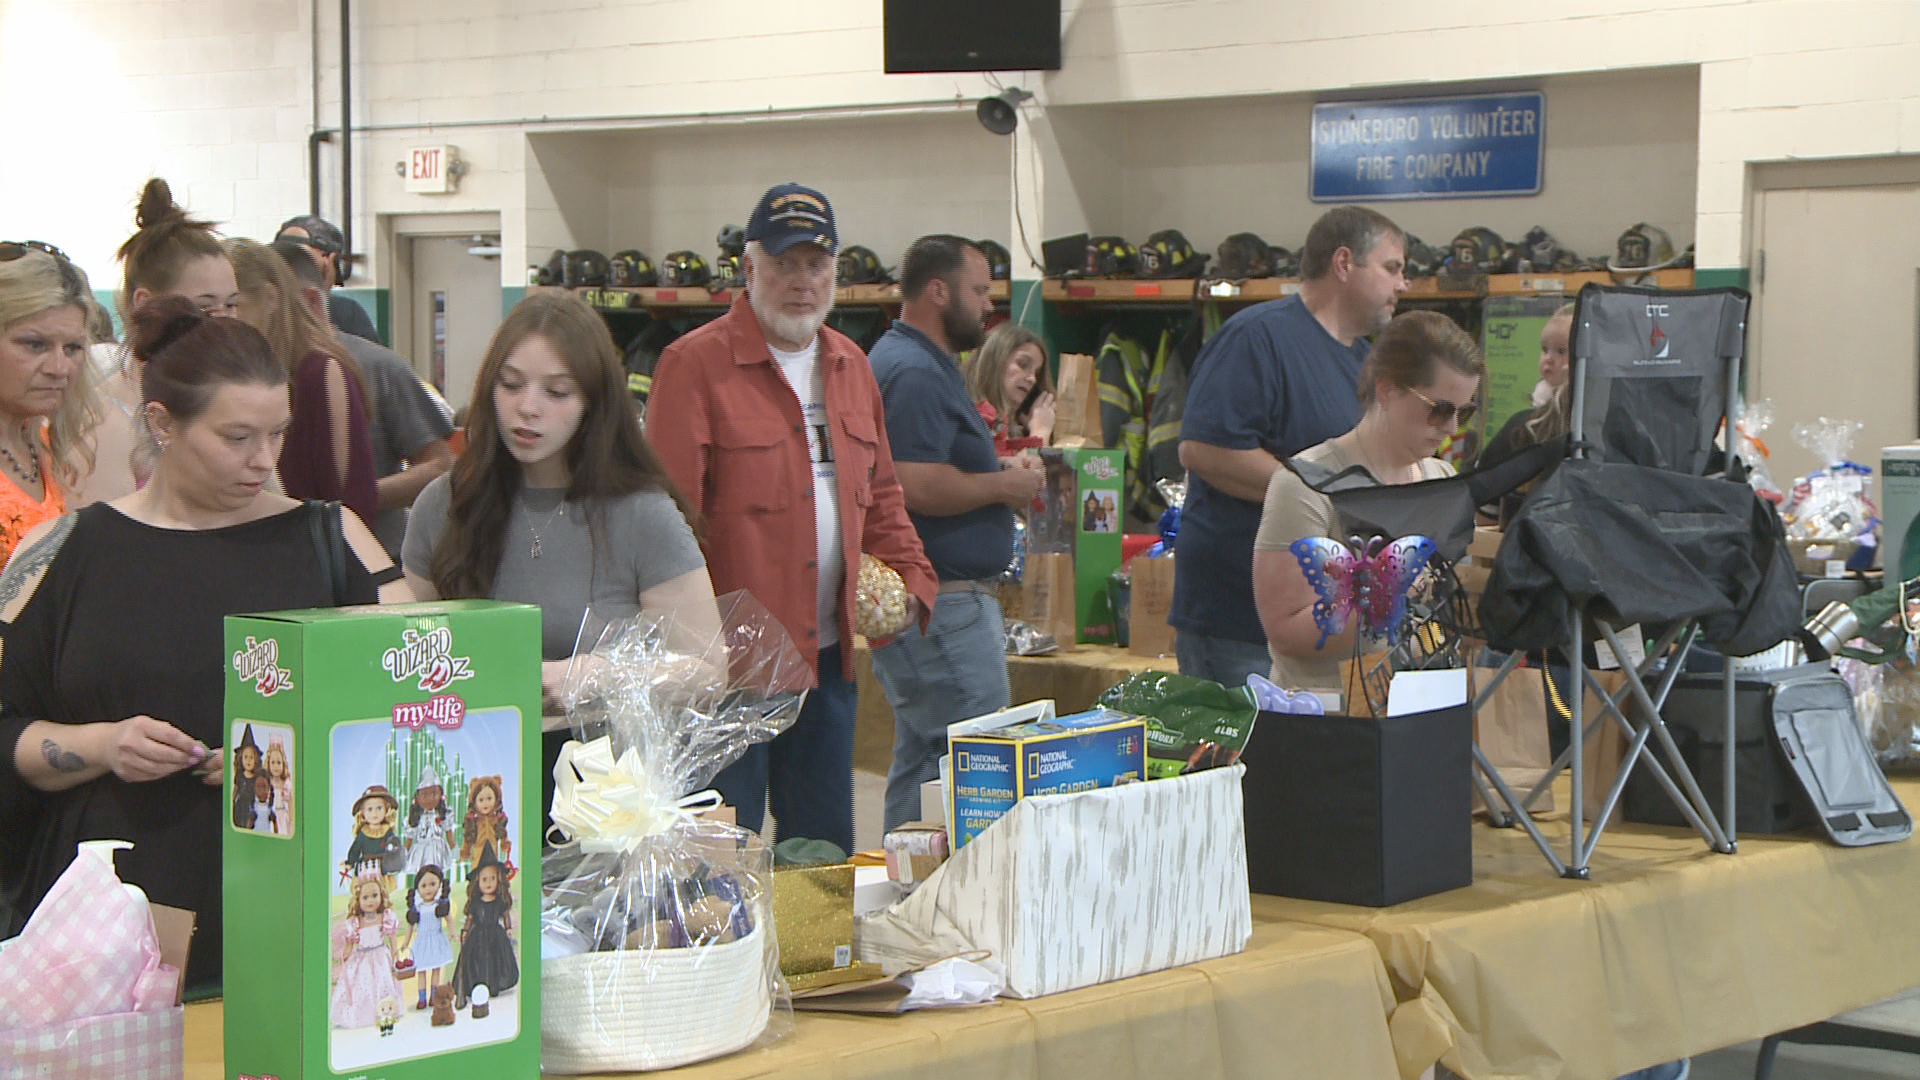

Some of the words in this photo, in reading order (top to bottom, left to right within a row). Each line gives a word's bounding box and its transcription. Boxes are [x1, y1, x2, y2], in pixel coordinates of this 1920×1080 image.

[1318, 116, 1420, 145] STONEBORO
[1430, 109, 1536, 140] VOLUNTEER
[413, 149, 440, 179] EXIT
[1356, 155, 1395, 181] FIRE
[1404, 151, 1491, 180] COMPANY
[404, 631, 418, 645] The
[234, 640, 278, 679] WIZARD
[384, 629, 450, 679] WIZARD
[970, 754, 1001, 763] NATIONAL
[1040, 750, 1068, 763] NATIONAL
[970, 763, 1009, 773] GEOGRAPHIC
[1040, 760, 1074, 775] GEOGRAPHIC
[957, 785, 979, 797] HERB
[980, 786, 1014, 799] GARDEN
[960, 808, 983, 817] LEARN
